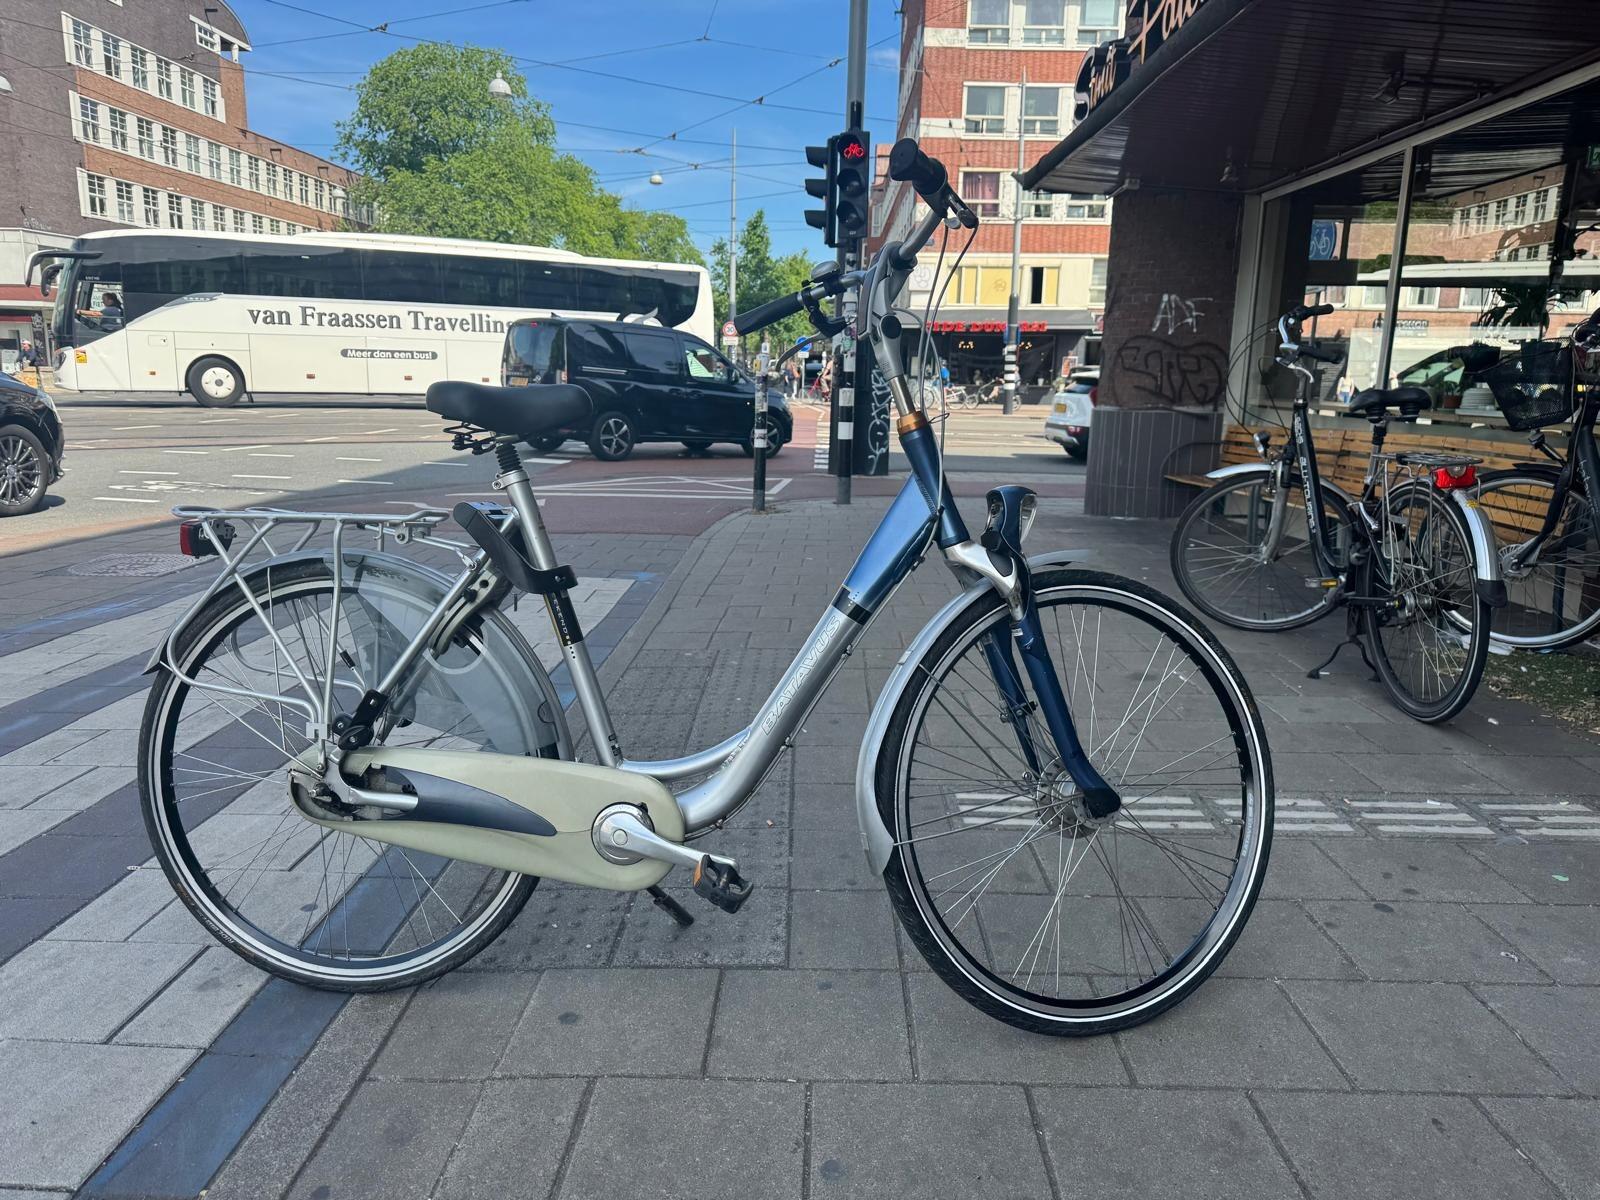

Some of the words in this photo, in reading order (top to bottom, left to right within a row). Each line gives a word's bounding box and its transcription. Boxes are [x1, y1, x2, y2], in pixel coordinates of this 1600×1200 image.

[247, 308, 292, 326] van
[299, 306, 401, 330] Fraassen
[346, 349, 372, 358] Meer
[373, 350, 392, 359] dan
[393, 351, 412, 360] een
[413, 351, 433, 360] bus!
[761, 615, 842, 736] BATAVUS
